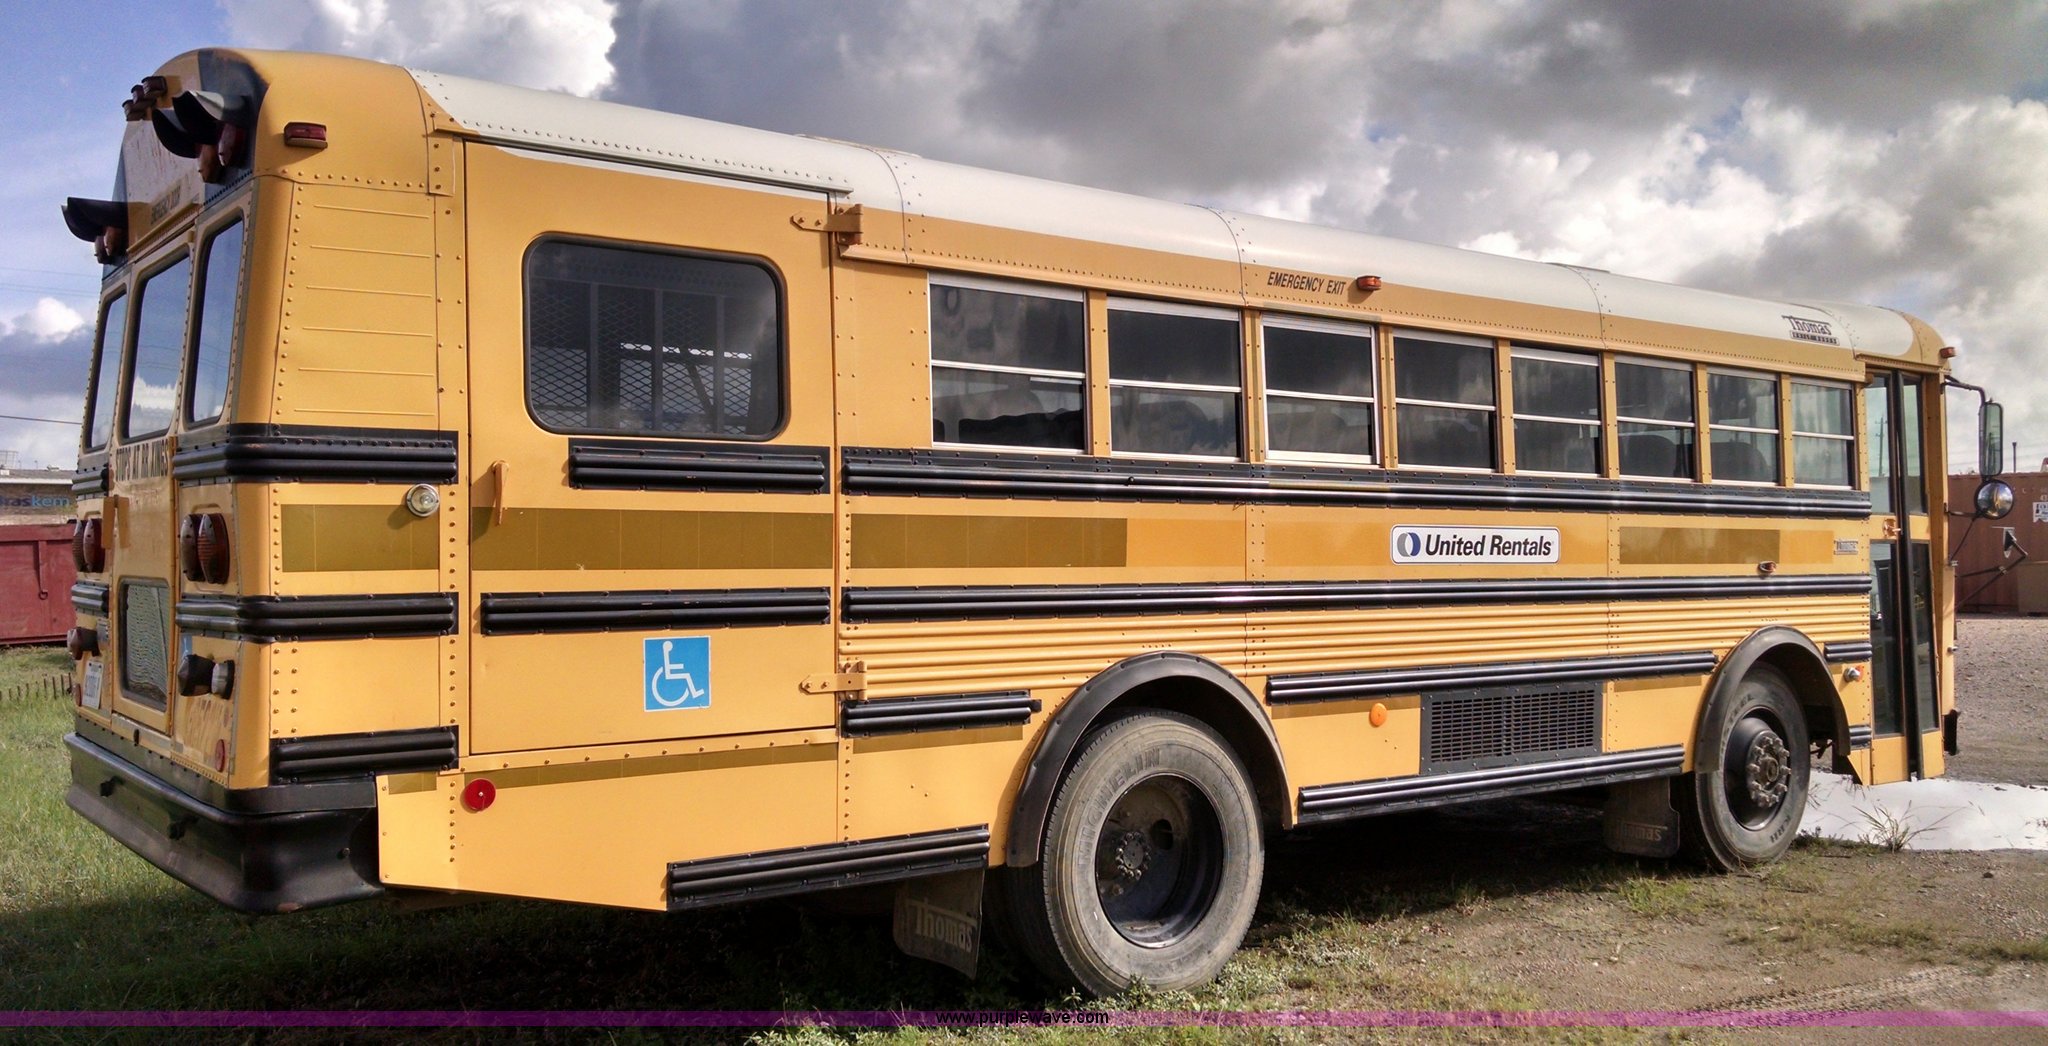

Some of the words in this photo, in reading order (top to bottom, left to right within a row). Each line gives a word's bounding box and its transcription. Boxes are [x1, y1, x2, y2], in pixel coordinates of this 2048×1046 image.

[1267, 271, 1325, 292] EMERGENCY
[1326, 280, 1347, 295] EXIT
[1781, 315, 1832, 335] Thomas
[1425, 534, 1486, 556] United
[1489, 535, 1552, 556] Rentals
[908, 898, 977, 953] Thomas
